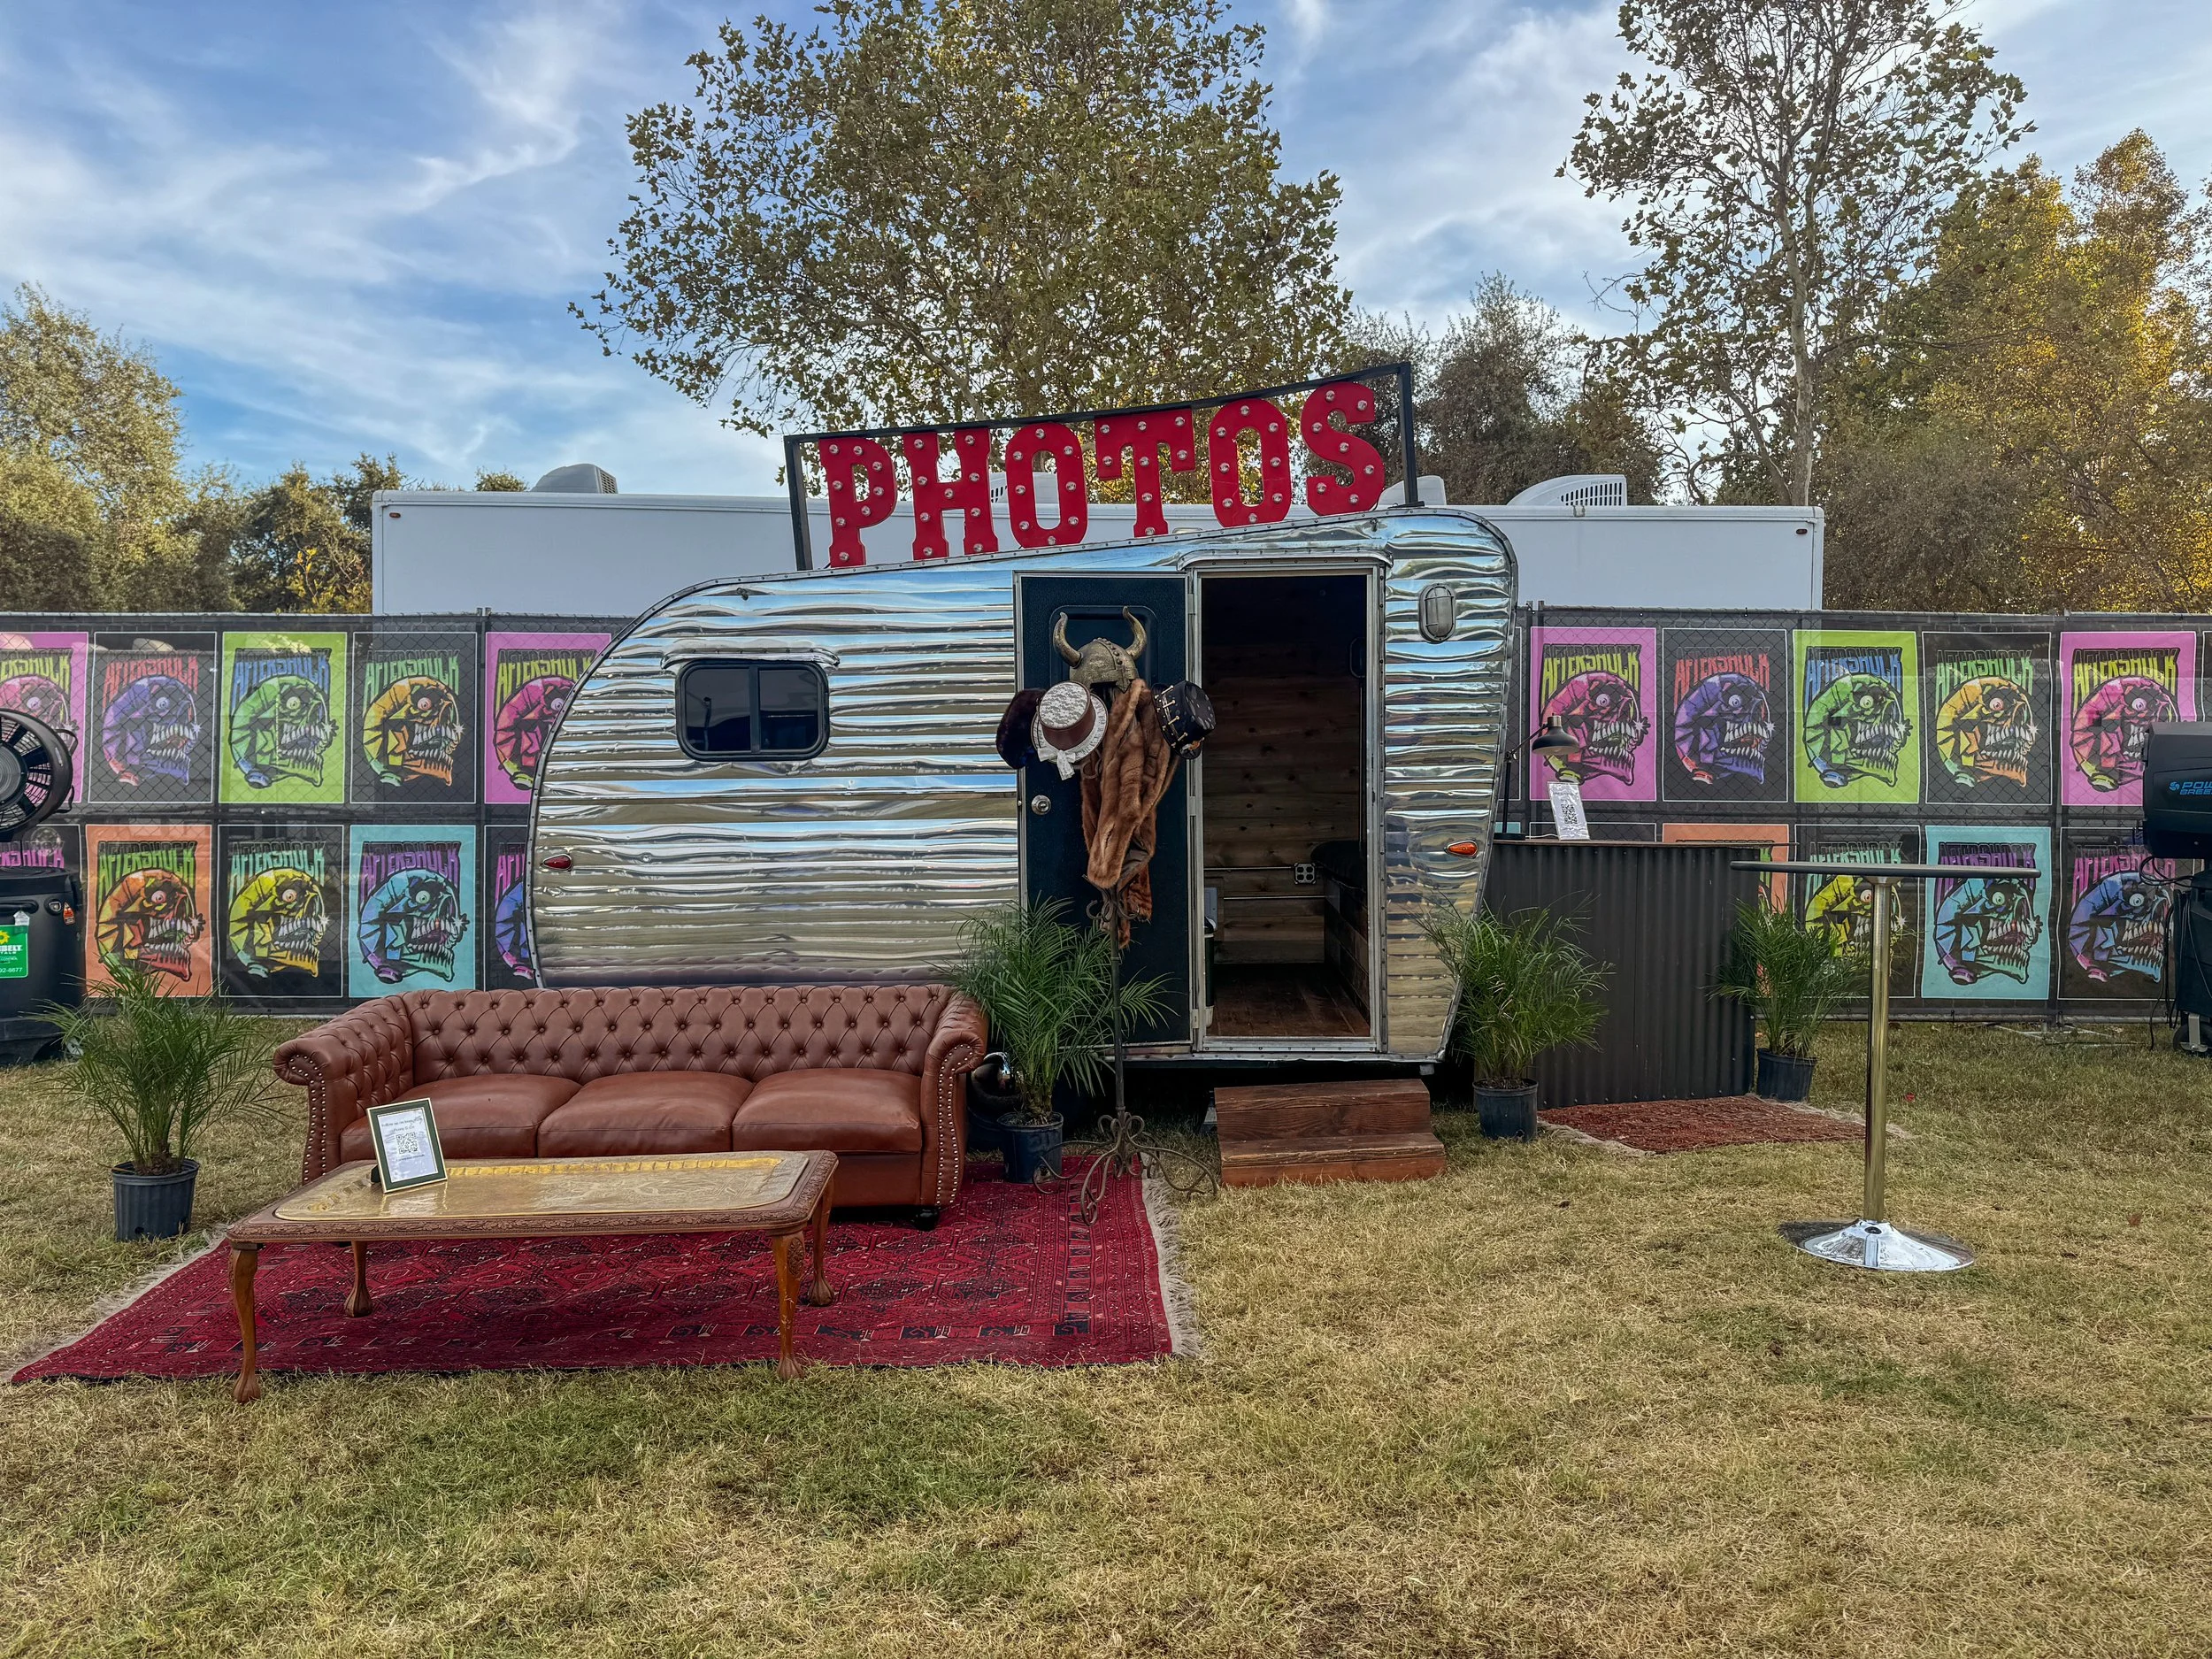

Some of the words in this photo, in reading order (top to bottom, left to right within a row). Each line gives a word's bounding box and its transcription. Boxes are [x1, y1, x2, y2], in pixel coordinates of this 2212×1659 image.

[818, 381, 1385, 568] PHOTOS
[103, 650, 199, 715] AFTERSHOCK
[230, 649, 331, 715] AFTERSHOCK
[362, 650, 460, 718] AFTERSHOCK
[1540, 644, 1641, 712] AFTERSHOCK
[1674, 647, 1770, 713] AFTERSHOCK
[1805, 647, 1901, 714] AFTERSHOCK
[1936, 650, 2033, 718] AFTERSHOCK
[2072, 648, 2179, 718] AFTERSHOCK
[98, 841, 196, 910] AFTERSHOCK
[228, 841, 326, 910] AFTERSHOCK
[359, 841, 461, 910] AFTERSHOCK
